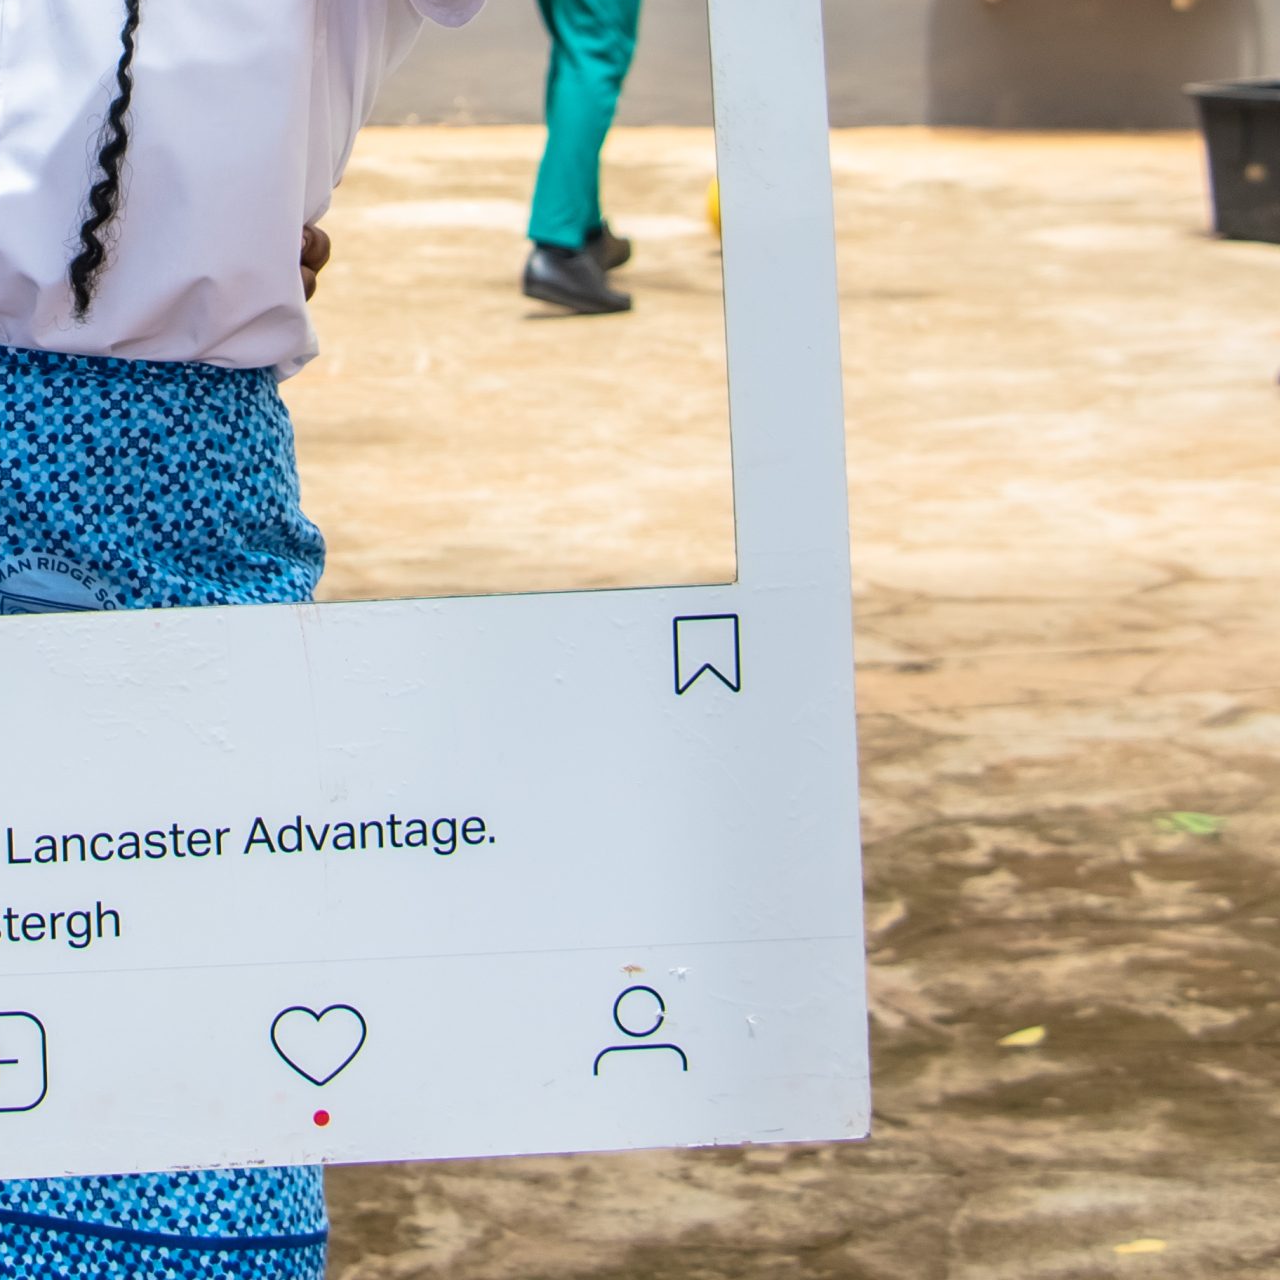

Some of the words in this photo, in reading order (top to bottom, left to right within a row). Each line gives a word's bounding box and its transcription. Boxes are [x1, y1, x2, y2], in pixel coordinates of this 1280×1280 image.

[37, 556, 97, 591] RIDGE
[6, 823, 231, 865] Lancaster
[243, 813, 495, 857] Advantage.
